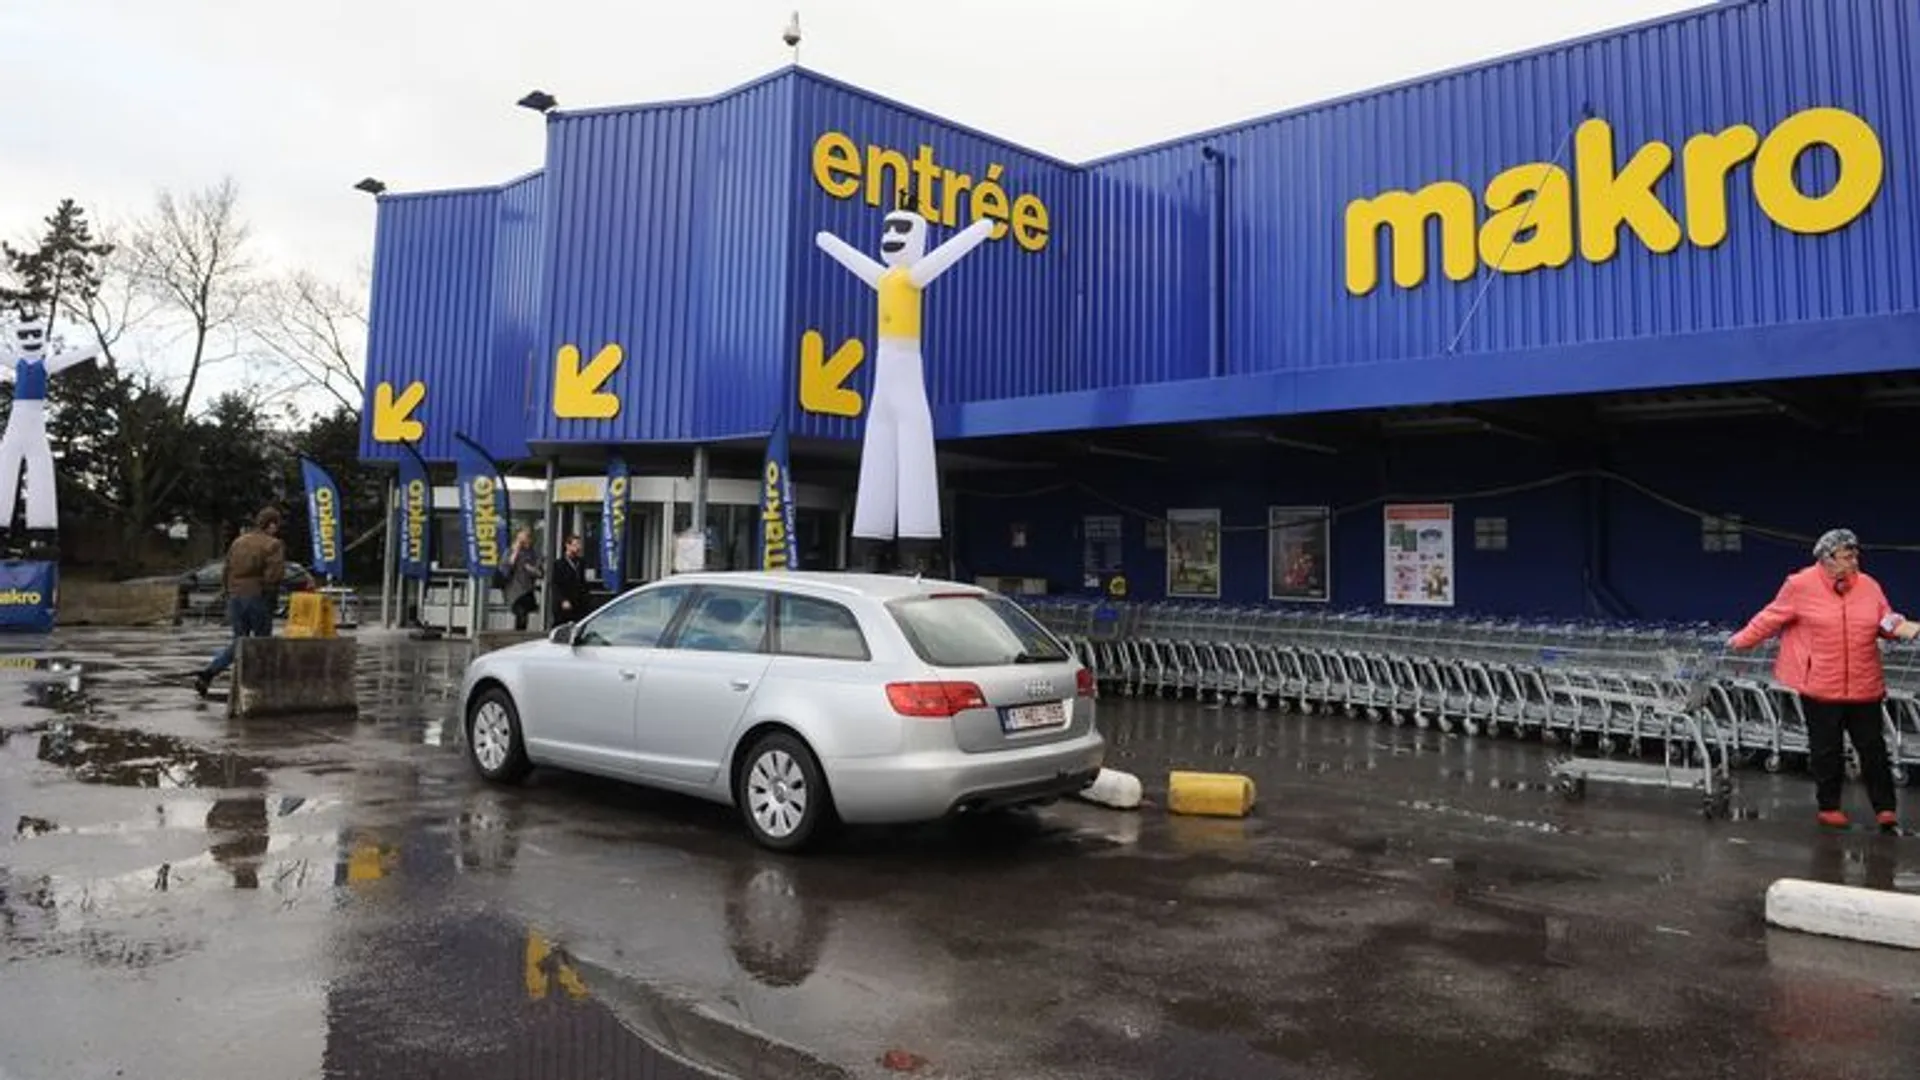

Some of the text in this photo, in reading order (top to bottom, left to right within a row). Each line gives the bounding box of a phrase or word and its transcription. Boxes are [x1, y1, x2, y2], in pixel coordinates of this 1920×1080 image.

[813, 131, 1049, 250] entrée
[1345, 108, 1884, 295] makro
[763, 461, 788, 573] makro
